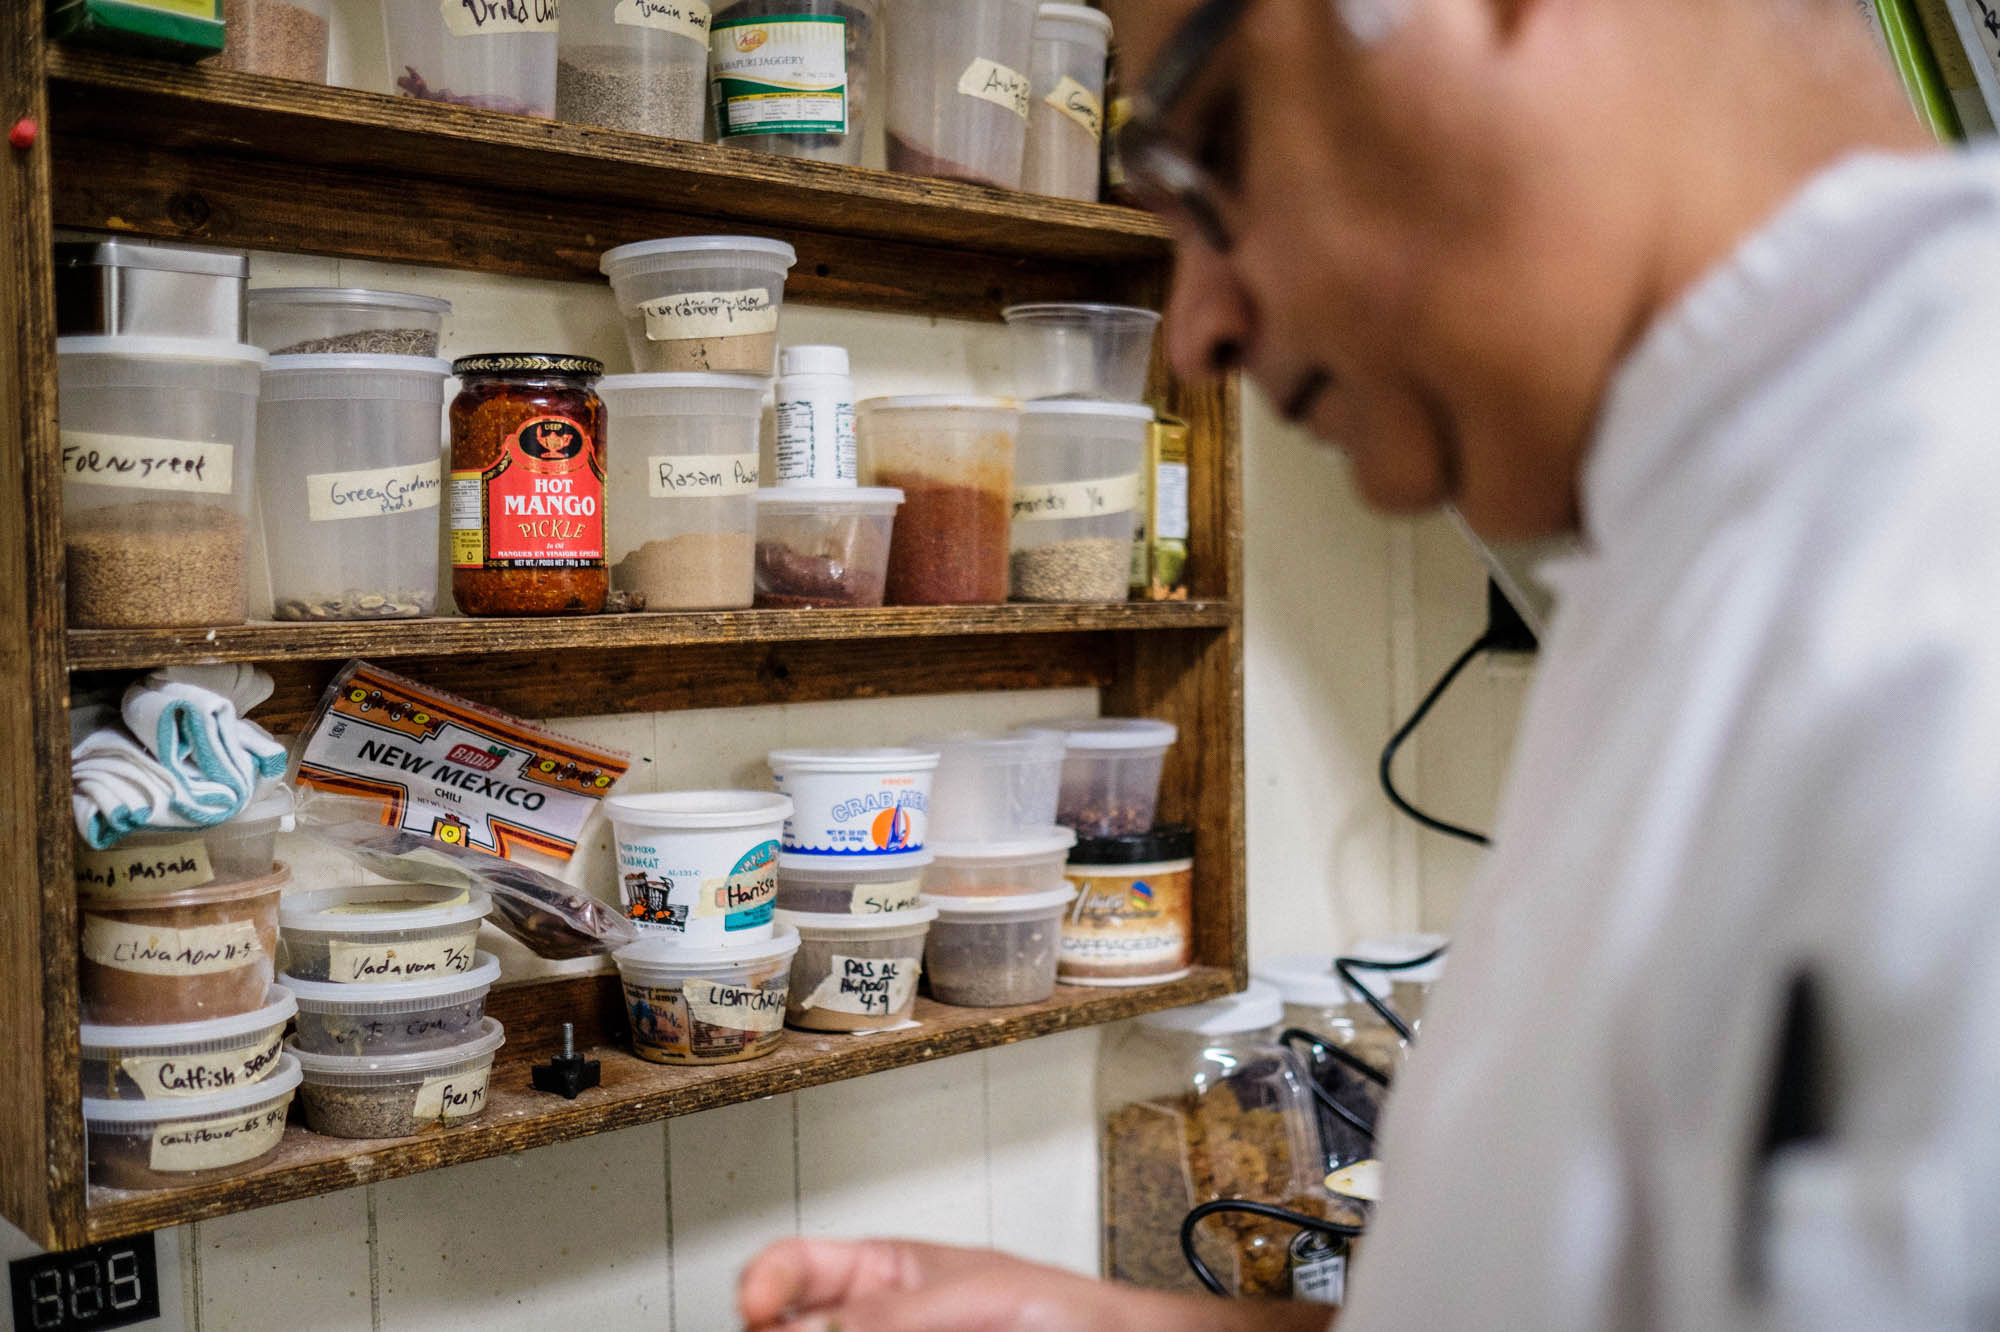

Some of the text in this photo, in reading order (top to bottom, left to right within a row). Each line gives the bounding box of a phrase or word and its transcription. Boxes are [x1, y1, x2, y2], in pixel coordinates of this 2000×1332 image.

[535, 478, 573, 494] HOT
[659, 462, 723, 490] Rasam
[504, 495, 596, 517] MANGO
[518, 518, 587, 541] PICKLE
[451, 747, 497, 770] BADIA
[357, 739, 546, 812] NEW MEXICO
[434, 787, 463, 804] CHILI
[831, 791, 894, 823] CRAB
[728, 879, 775, 908] Harissa
[159, 1062, 236, 1090] Catfish
